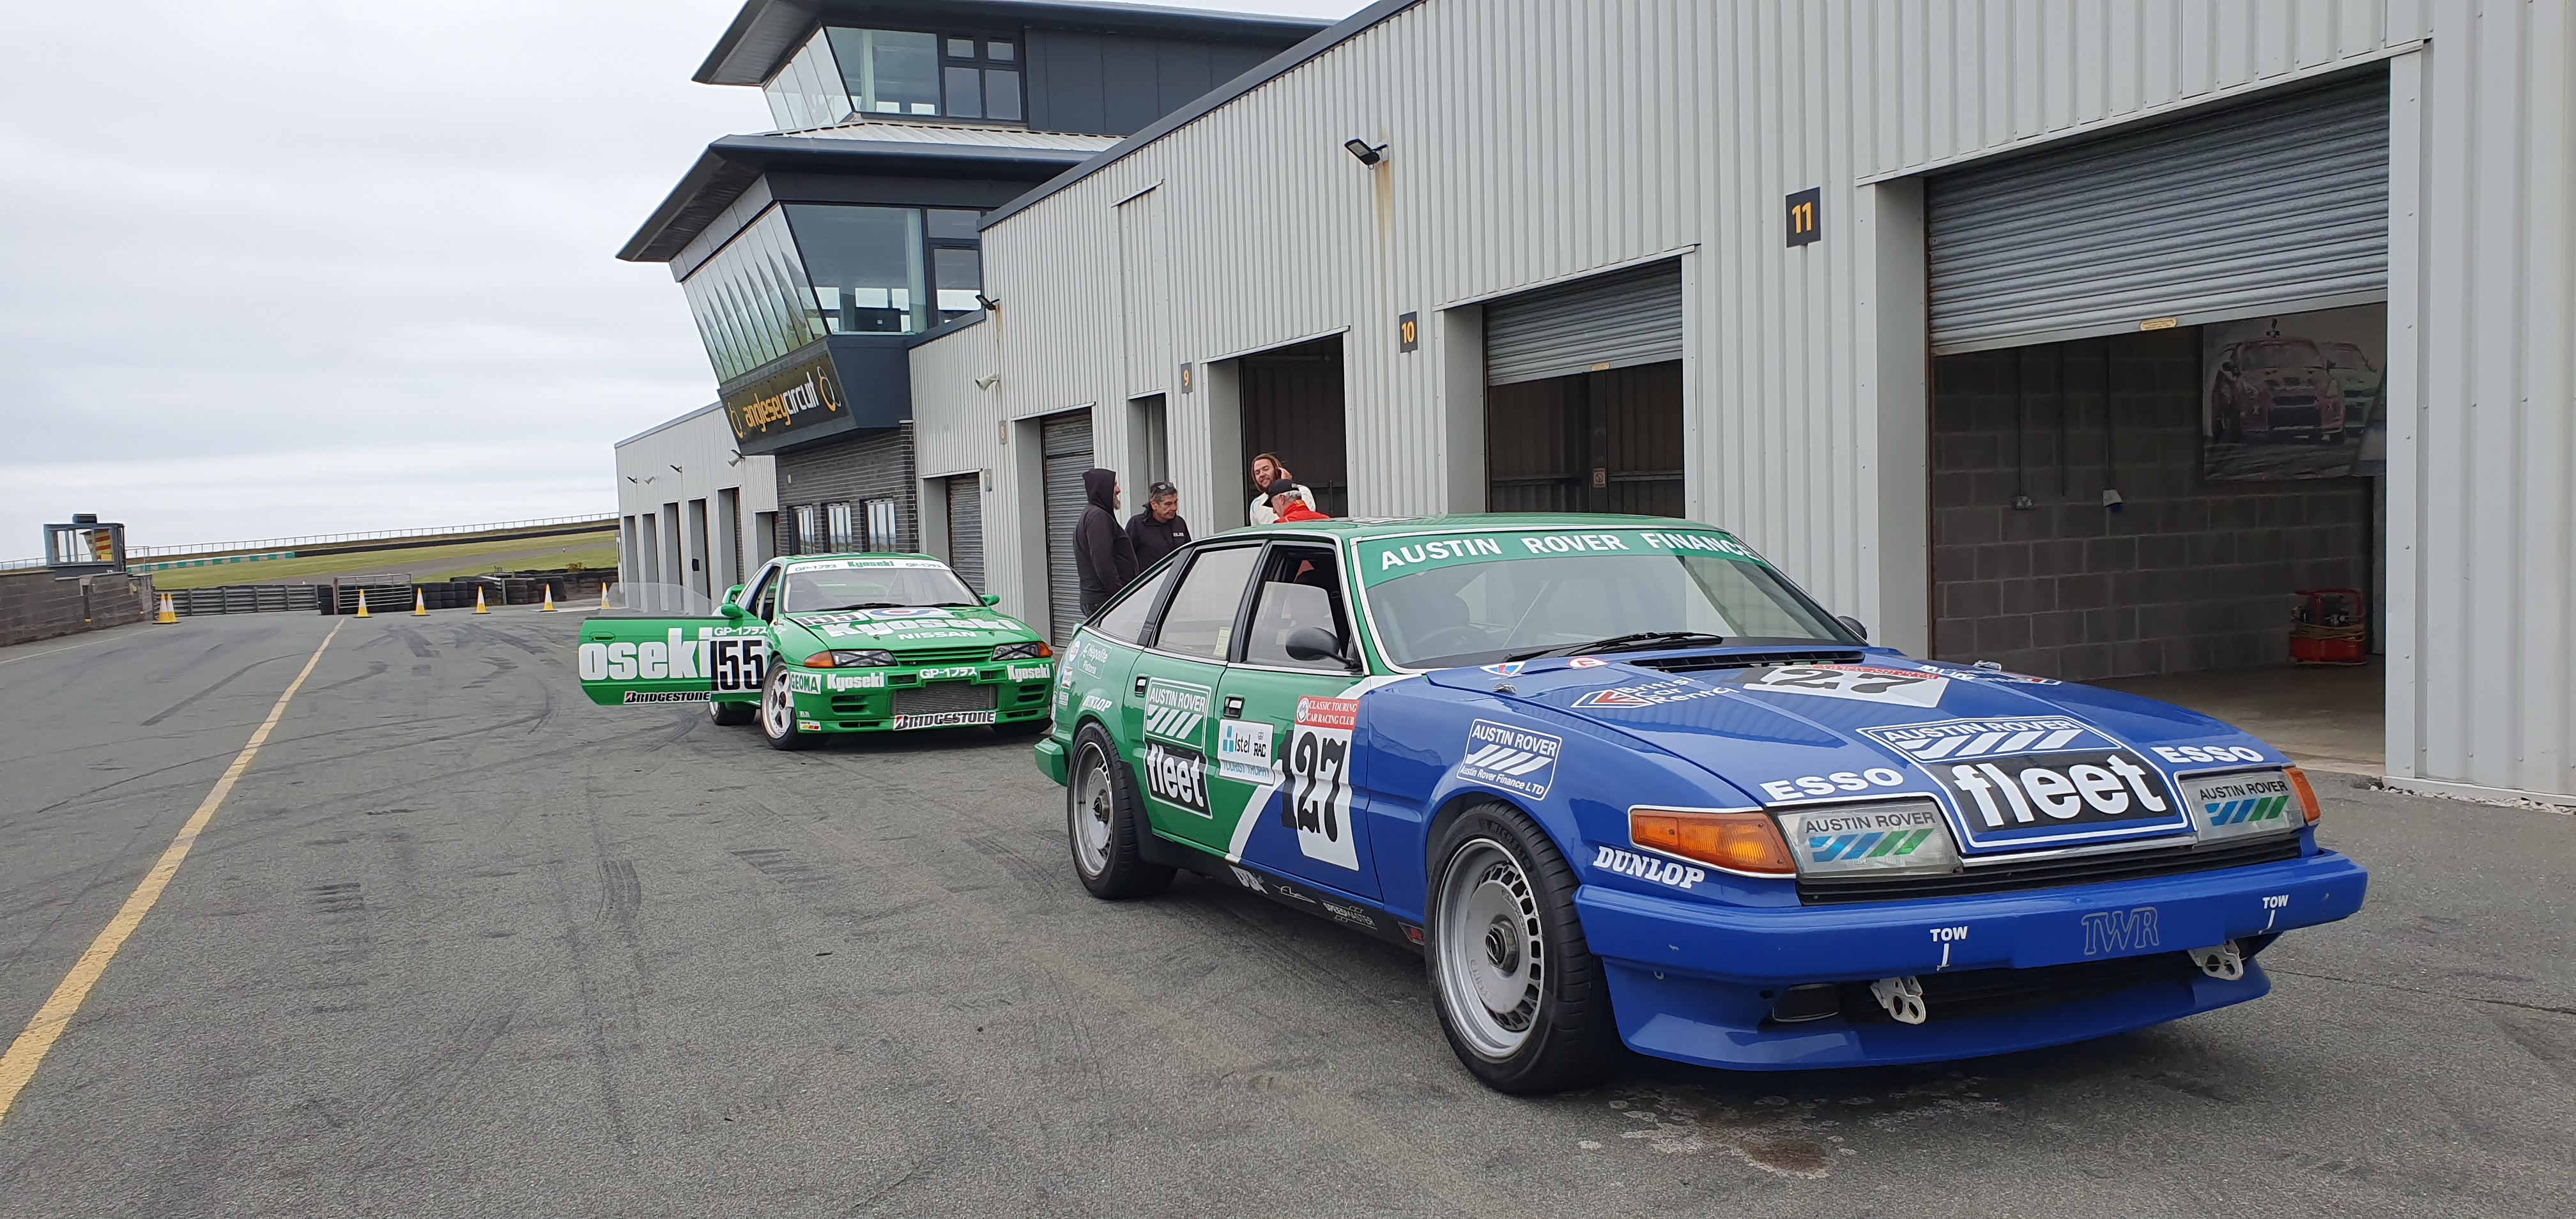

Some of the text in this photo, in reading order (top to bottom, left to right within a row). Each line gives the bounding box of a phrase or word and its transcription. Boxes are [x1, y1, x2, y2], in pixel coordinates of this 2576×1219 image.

[1791, 201, 1812, 234] 11
[1402, 321, 1414, 343] 10
[1183, 369, 1189, 387] 9
[1000, 426, 1005, 438] 8
[986, 474, 990, 486] 7
[1382, 532, 1761, 570] AUSTIN ROVER FINANCE
[797, 613, 861, 625] 155
[820, 618, 1023, 638] Kyoseki
[898, 631, 977, 640] NISSAN
[578, 627, 712, 680] oseki
[710, 640, 764, 691] 155
[1007, 664, 1050, 682] Kyoseki
[790, 673, 819, 693] GEOMA
[827, 672, 884, 692] Kyoseki
[1722, 667, 1926, 694] 127
[625, 692, 710, 703] BRIDGESTONE
[1150, 687, 1206, 712] AUSTIN ROVER
[1635, 687, 1683, 698] Car
[1083, 695, 1112, 712] DUNLOP
[1309, 700, 1358, 713] CLASSIC TOURING
[895, 712, 996, 730] BRIDGESTONE
[1307, 713, 1354, 726] CAR RACING CLUB
[1471, 724, 1557, 756] AUSTIN ROVER
[1886, 719, 2077, 742] AUSTIN ROVER
[1235, 733, 1250, 753] Istel
[1254, 742, 1266, 757] RAC
[2150, 746, 2264, 763] ESSO
[1147, 744, 1204, 807] fleet
[1223, 761, 1269, 778] TOURIST TROPHY
[1278, 730, 1347, 843] 127
[1460, 765, 1544, 795] Austin Rover Finance LTD
[1759, 768, 1904, 801] ESSO
[1951, 755, 2166, 827] fleet
[2200, 781, 2288, 801] AUSTIN ROVER
[1805, 811, 1936, 833] AUSTIN ROVER
[1593, 846, 1705, 889] DUNLOP
[2262, 894, 2288, 909] TOW
[1930, 926, 1968, 942] TOW
[2081, 907, 2159, 955] TWR
